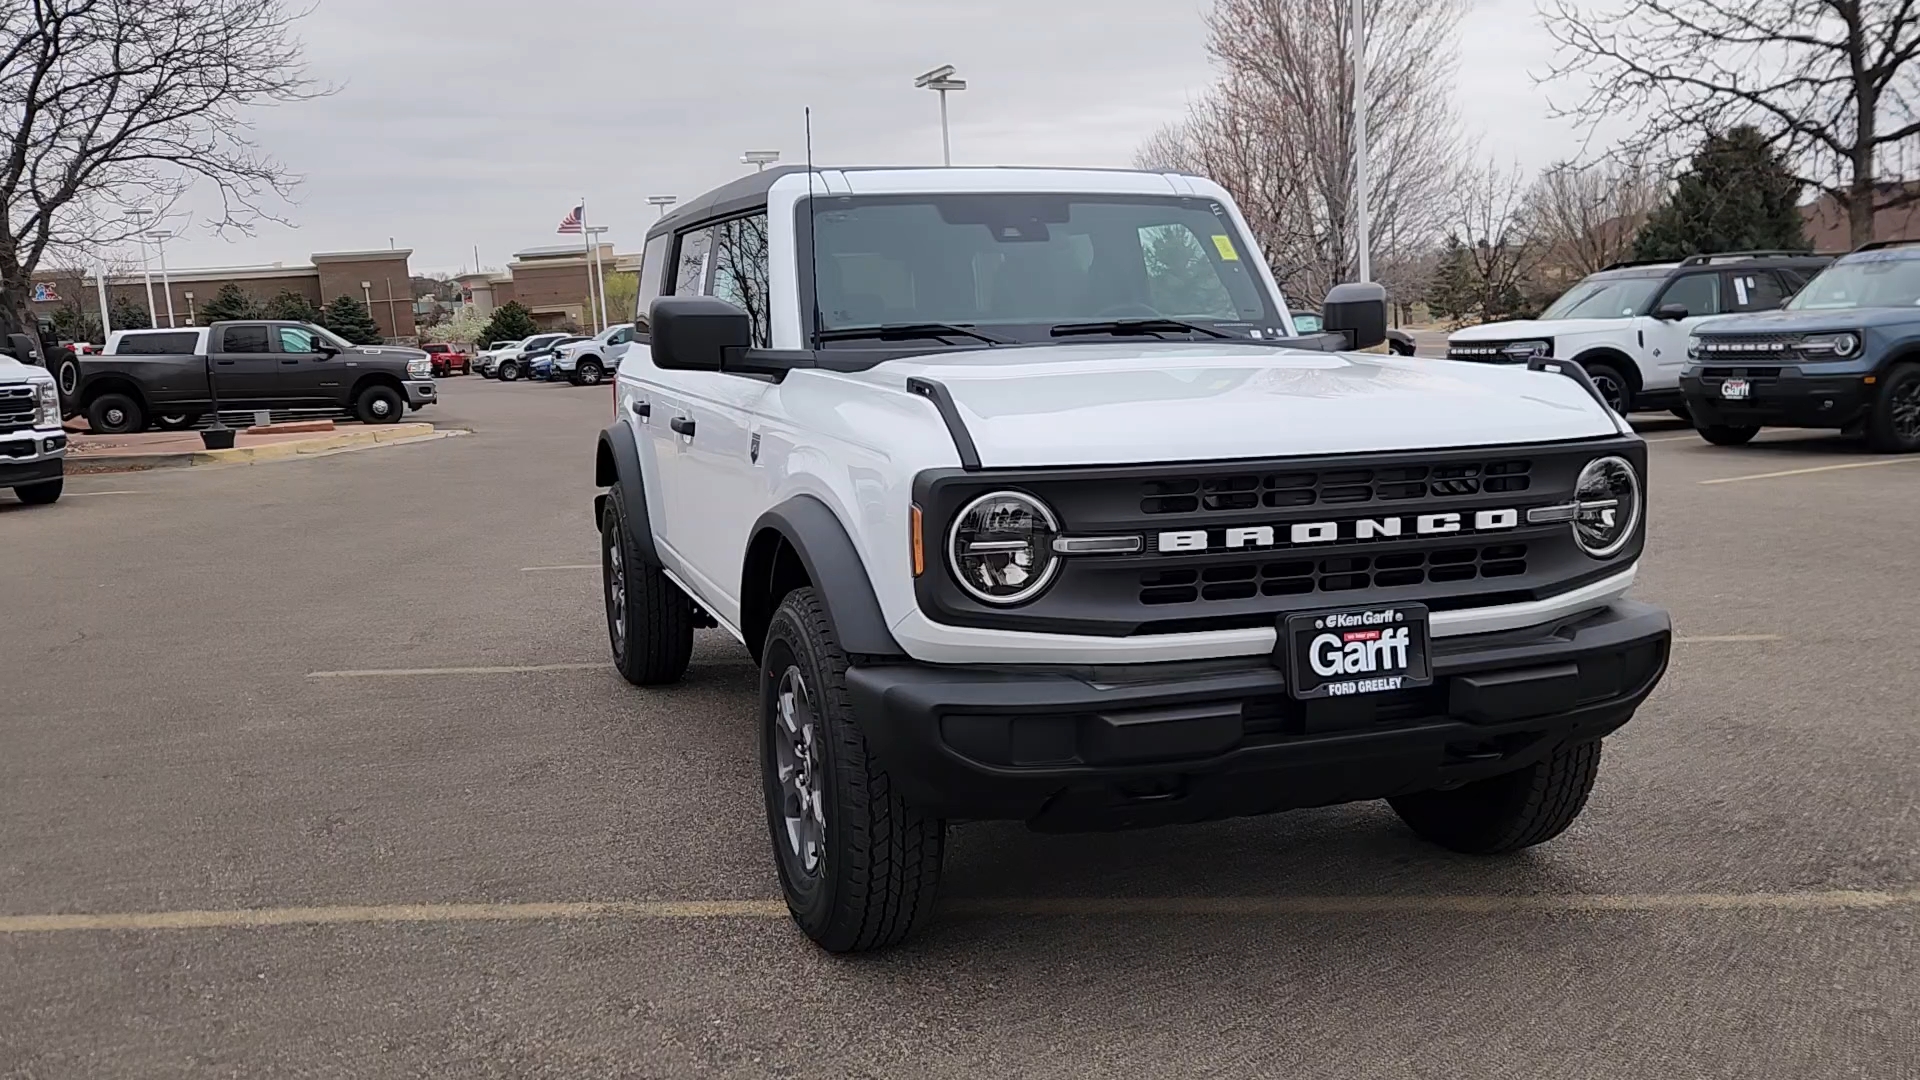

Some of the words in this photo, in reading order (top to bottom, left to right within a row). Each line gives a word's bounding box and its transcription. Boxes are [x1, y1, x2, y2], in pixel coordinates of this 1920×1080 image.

[1158, 509, 1517, 552] BRONCO
[1338, 614, 1363, 627] Ken
[1363, 610, 1394, 625] Garff
[1309, 627, 1409, 676] Garff
[1329, 683, 1356, 696] FORD
[1358, 677, 1402, 693] GREELEY
